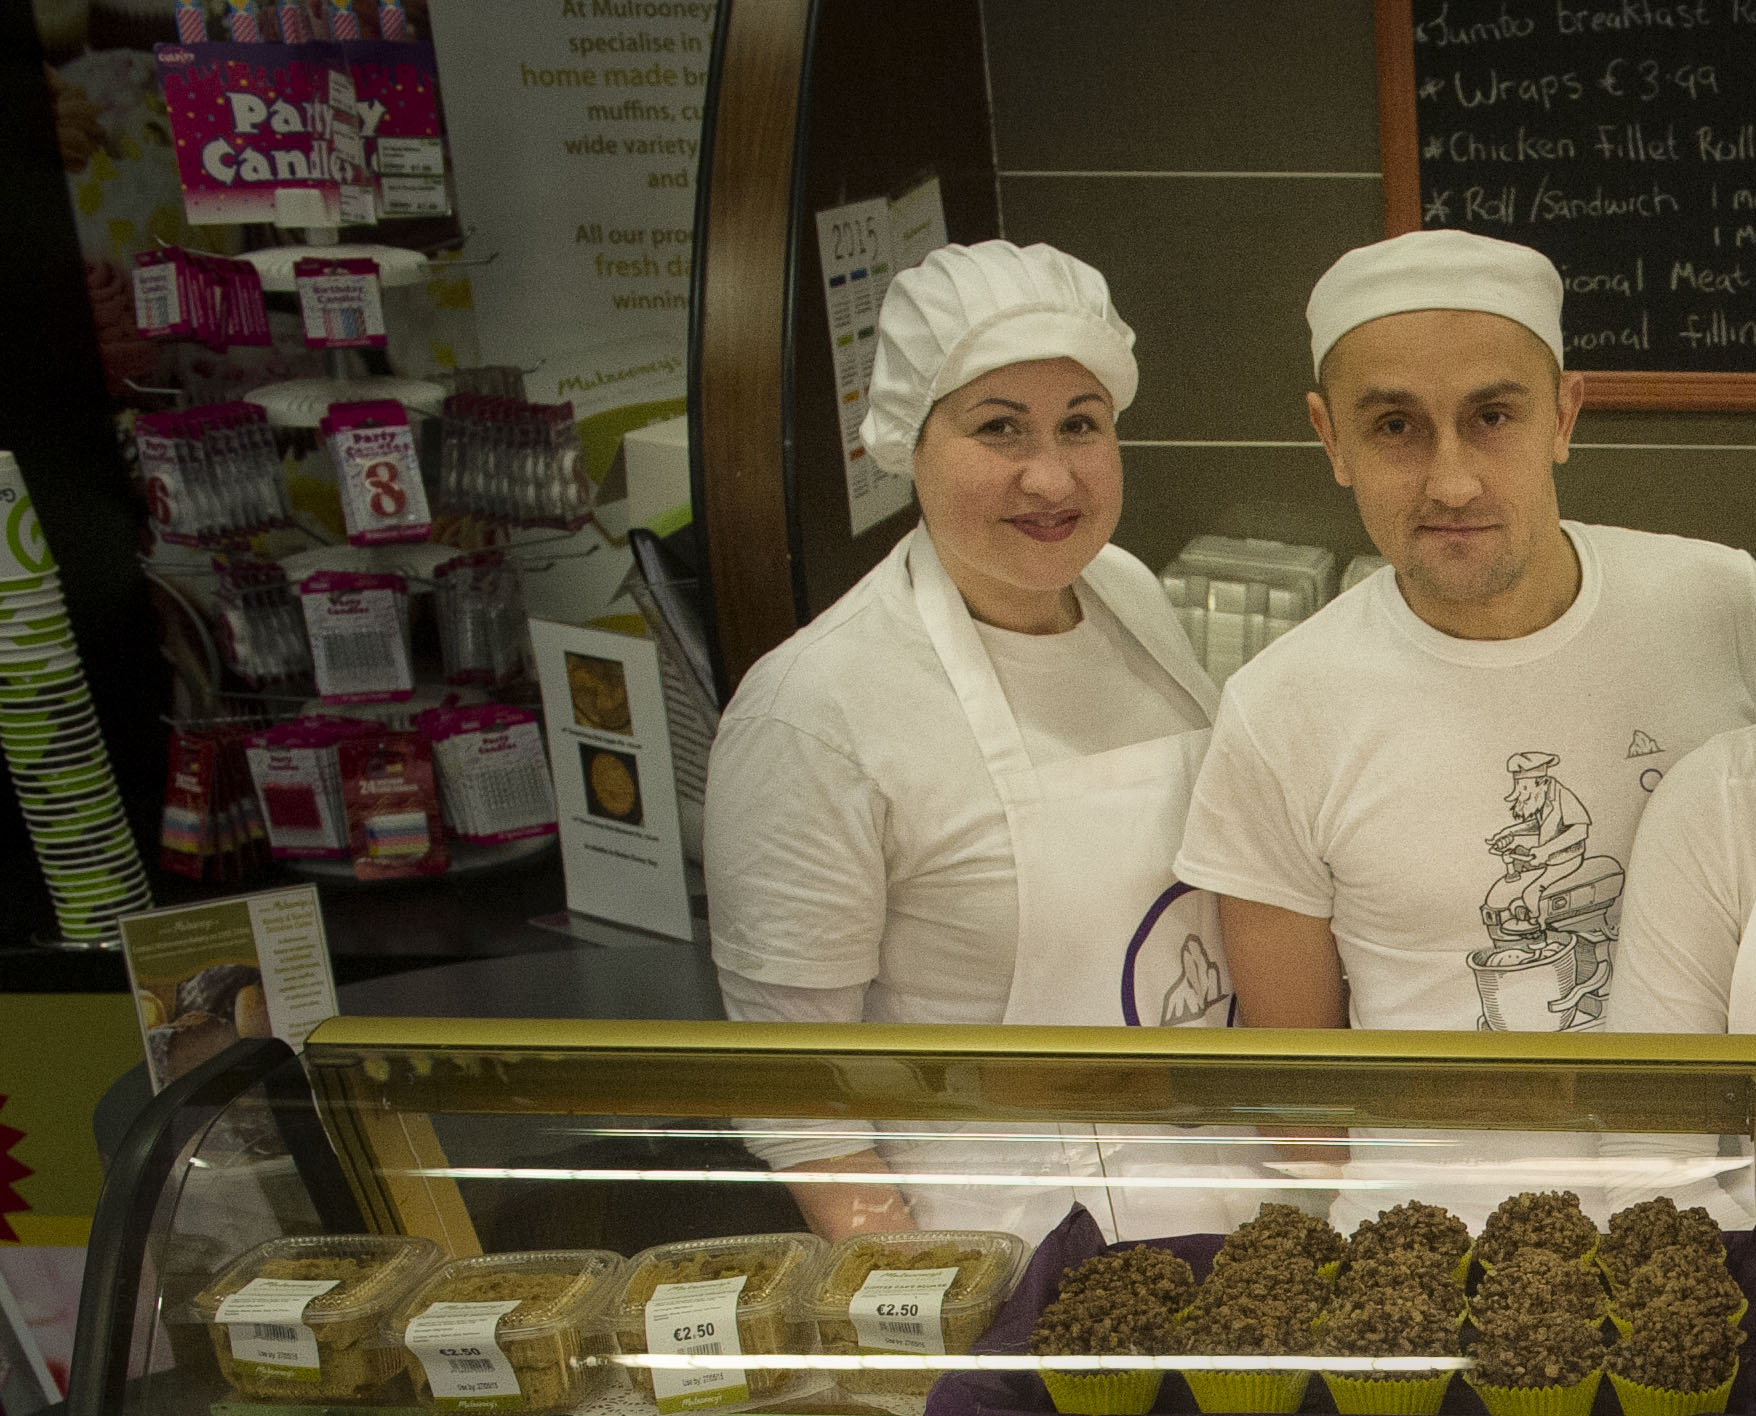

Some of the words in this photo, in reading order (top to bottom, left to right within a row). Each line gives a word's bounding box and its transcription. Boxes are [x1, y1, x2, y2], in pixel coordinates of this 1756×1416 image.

[562, 0, 587, 19] At
[568, 31, 676, 57] specialise
[681, 32, 702, 51] in
[520, 61, 596, 88] home
[604, 62, 678, 88] made
[1454, 68, 1584, 112] Wraps
[587, 101, 676, 123] muffins,
[564, 135, 617, 156] wide
[624, 136, 697, 158] variety
[1450, 126, 1576, 162] Chicken
[648, 169, 689, 189] and
[1466, 185, 1516, 224] Roll
[575, 225, 603, 245] All
[608, 228, 644, 244] our
[594, 252, 660, 278] fresh
[1563, 257, 1644, 298] ional
[1670, 260, 1751, 295] Meat
[366, 461, 406, 516] 8
[358, 779, 377, 796] 24
[876, 1303, 919, 1317] €2.50
[673, 1322, 715, 1342] €2.50
